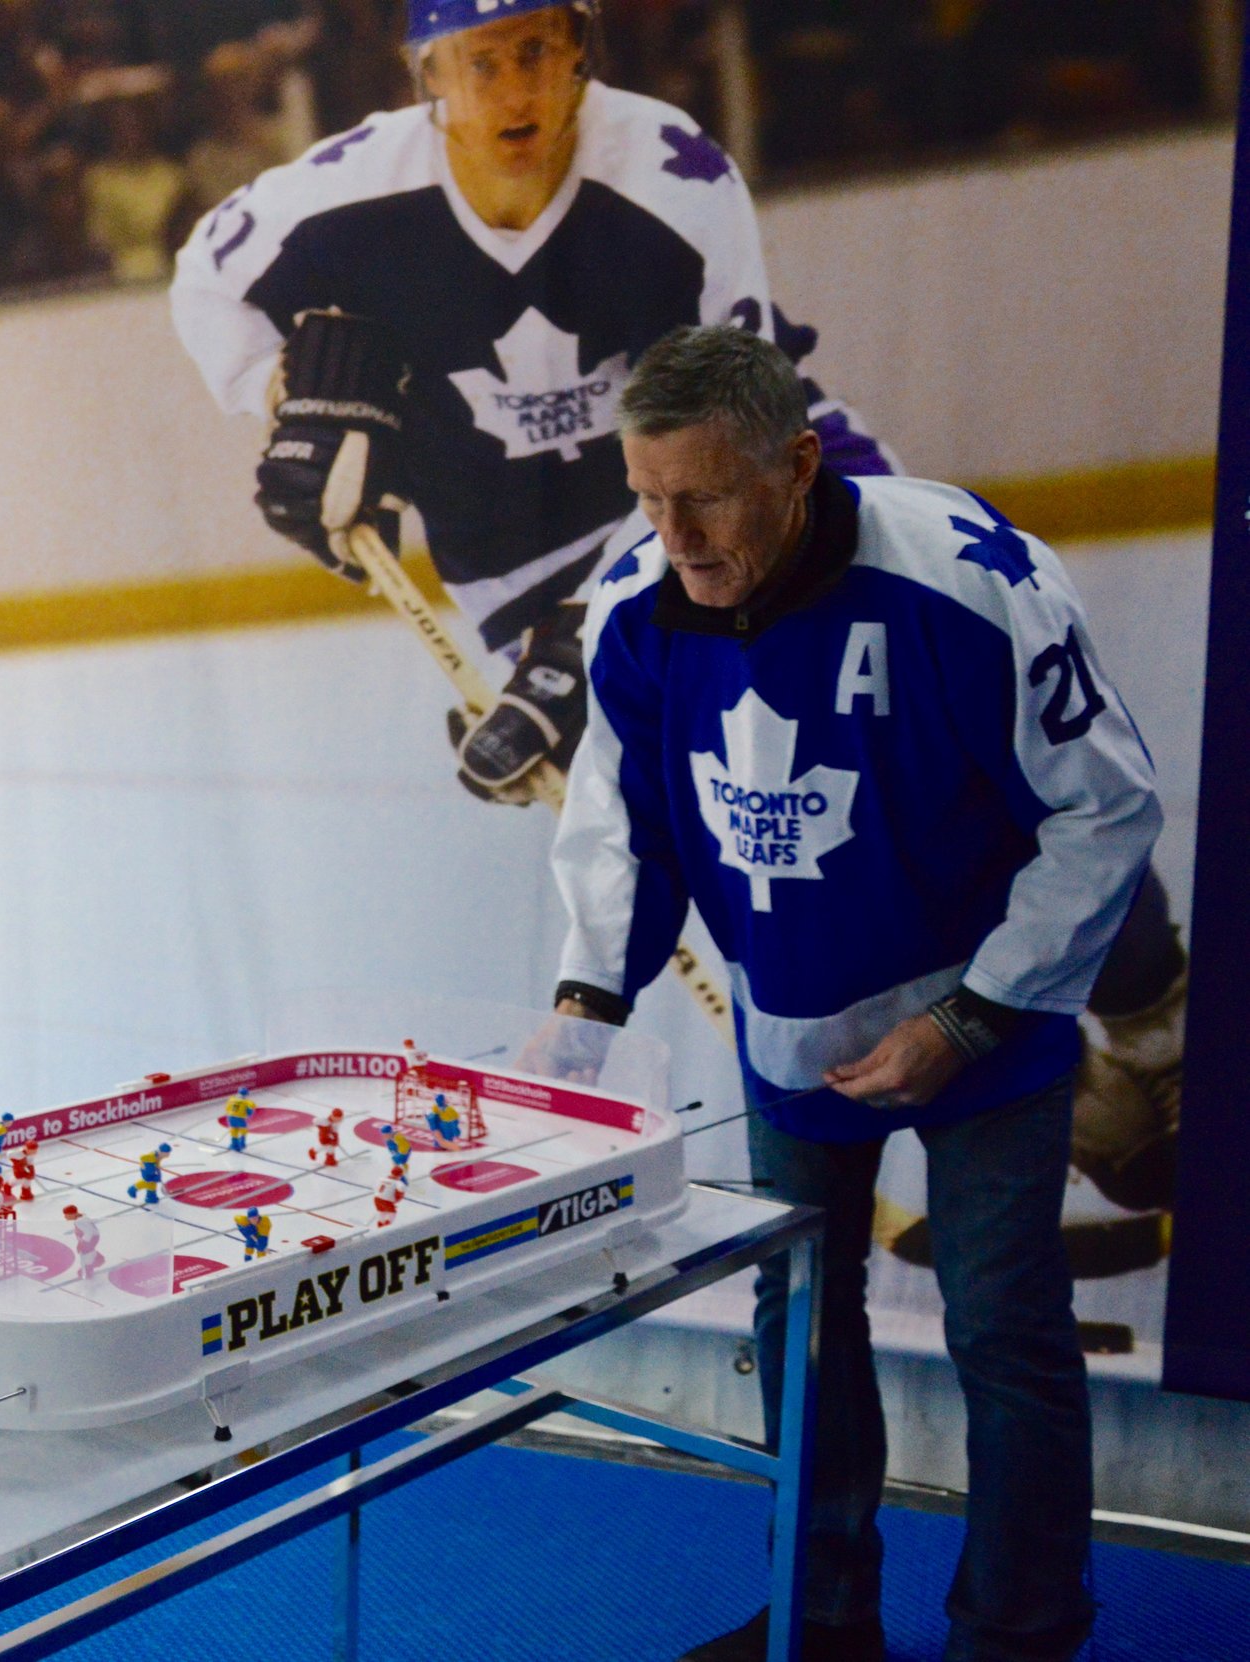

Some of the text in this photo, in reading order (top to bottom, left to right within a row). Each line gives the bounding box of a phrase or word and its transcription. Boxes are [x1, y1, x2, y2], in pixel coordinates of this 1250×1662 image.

[493, 380, 611, 410] TORONTO
[518, 401, 589, 428] MAPLE
[527, 417, 593, 444] LEAFS
[403, 600, 462, 671] JOFA
[835, 622, 890, 716] A
[1028, 624, 1107, 746] 21
[710, 779, 828, 816] TORONTO
[730, 809, 801, 840] MAPLE
[736, 835, 797, 866] LEAFS
[295, 1056, 401, 1076] #NHL100
[43, 1117, 62, 1136] to
[69, 1094, 162, 1130] Stockholm
[540, 1185, 618, 1234] STIGA
[227, 1235, 440, 1351] PLAY OFF
